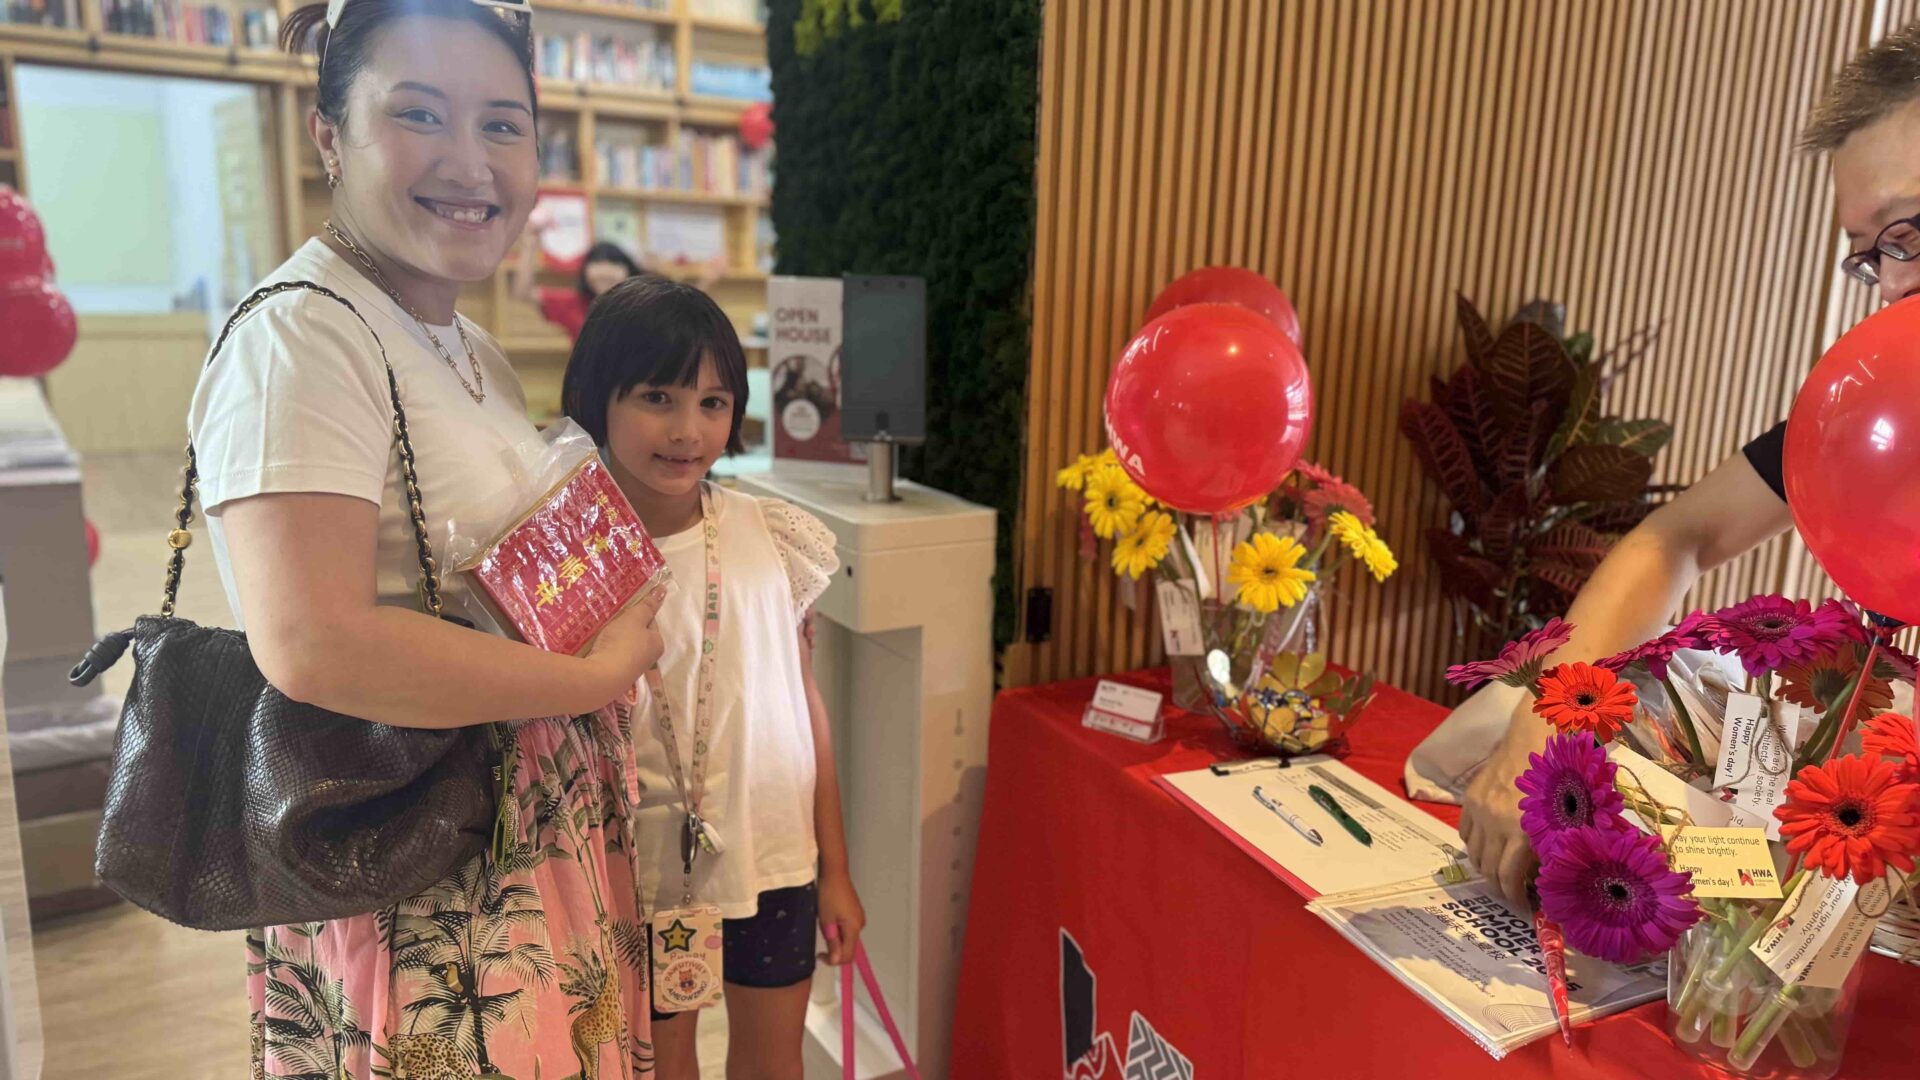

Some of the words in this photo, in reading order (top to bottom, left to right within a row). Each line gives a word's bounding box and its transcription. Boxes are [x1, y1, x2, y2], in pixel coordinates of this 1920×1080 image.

[775, 307, 818, 324] OPEN
[775, 326, 831, 344] HOUSE
[1728, 717, 1743, 757] Women's
[1742, 718, 1755, 746] Happy
[1771, 757, 1780, 773] are
[1752, 775, 1764, 807] society.
[1766, 789, 1775, 806] real
[1675, 845, 1684, 853] to
[1686, 846, 1705, 855] shine
[1707, 847, 1738, 856] brightly.
[1708, 835, 1725, 845] light
[1727, 837, 1760, 846] continue
[1680, 864, 1702, 874] Happy
[1752, 868, 1773, 878] HWA
[1687, 878, 1716, 886] omen's
[1830, 889, 1845, 911] your
[1456, 899, 1543, 955] SUMMER
[1473, 895, 1538, 942] BEYON
[1800, 902, 1828, 936] brightly.
[1817, 912, 1832, 933] light
[1442, 902, 1525, 957] SCHOOL
[1521, 957, 1584, 992] 205
[1763, 932, 1784, 954] HWA
[1785, 933, 1815, 970] continue
[1829, 931, 1849, 960] society.
[1841, 943, 1853, 958] real
